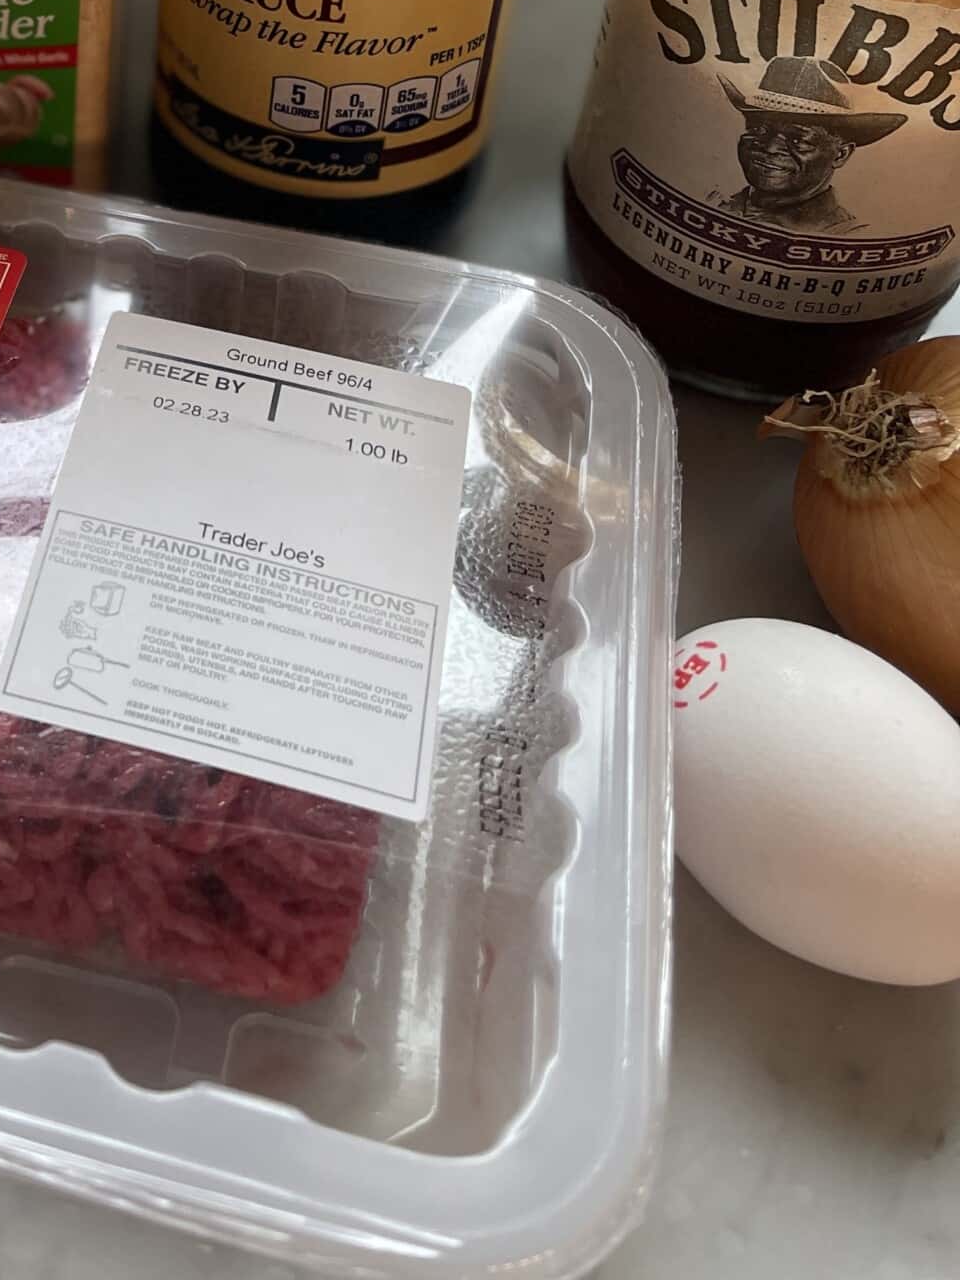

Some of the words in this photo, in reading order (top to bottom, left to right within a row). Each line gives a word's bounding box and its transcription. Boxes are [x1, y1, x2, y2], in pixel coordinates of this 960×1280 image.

[257, 19, 306, 50] the
[429, 43, 455, 66] PER
[466, 32, 486, 53] TSP
[274, 103, 320, 119] CALORIES
[291, 84, 306, 106] 5
[391, 100, 427, 115] SODIUM
[335, 108, 353, 118] SAT
[356, 108, 374, 118] FAT
[623, 166, 771, 251] STICKY
[786, 236, 937, 264] SWEET
[612, 192, 733, 275] LEGENDARY
[741, 261, 844, 297] BAR-B-Q
[856, 268, 927, 294] SAUCE
[651, 251, 690, 281] NET
[697, 277, 731, 297] WT
[737, 287, 786, 311] 18oz
[124, 356, 209, 386] FREEZE
[214, 375, 246, 394] BY
[226, 348, 288, 372] Ground
[294, 362, 332, 382] Beef
[337, 372, 373, 392] 96/4
[153, 396, 230, 424] 02.28.23
[327, 401, 373, 425] NET
[378, 415, 417, 436] WT.
[344, 438, 386, 461] 1.00
[392, 448, 409, 465] lb
[199, 522, 268, 553] Trader
[270, 541, 326, 568] Joe's
[80, 519, 137, 543] SAFE
[140, 534, 250, 571] HANDLING
[256, 562, 416, 616] INSTRUCTIONS
